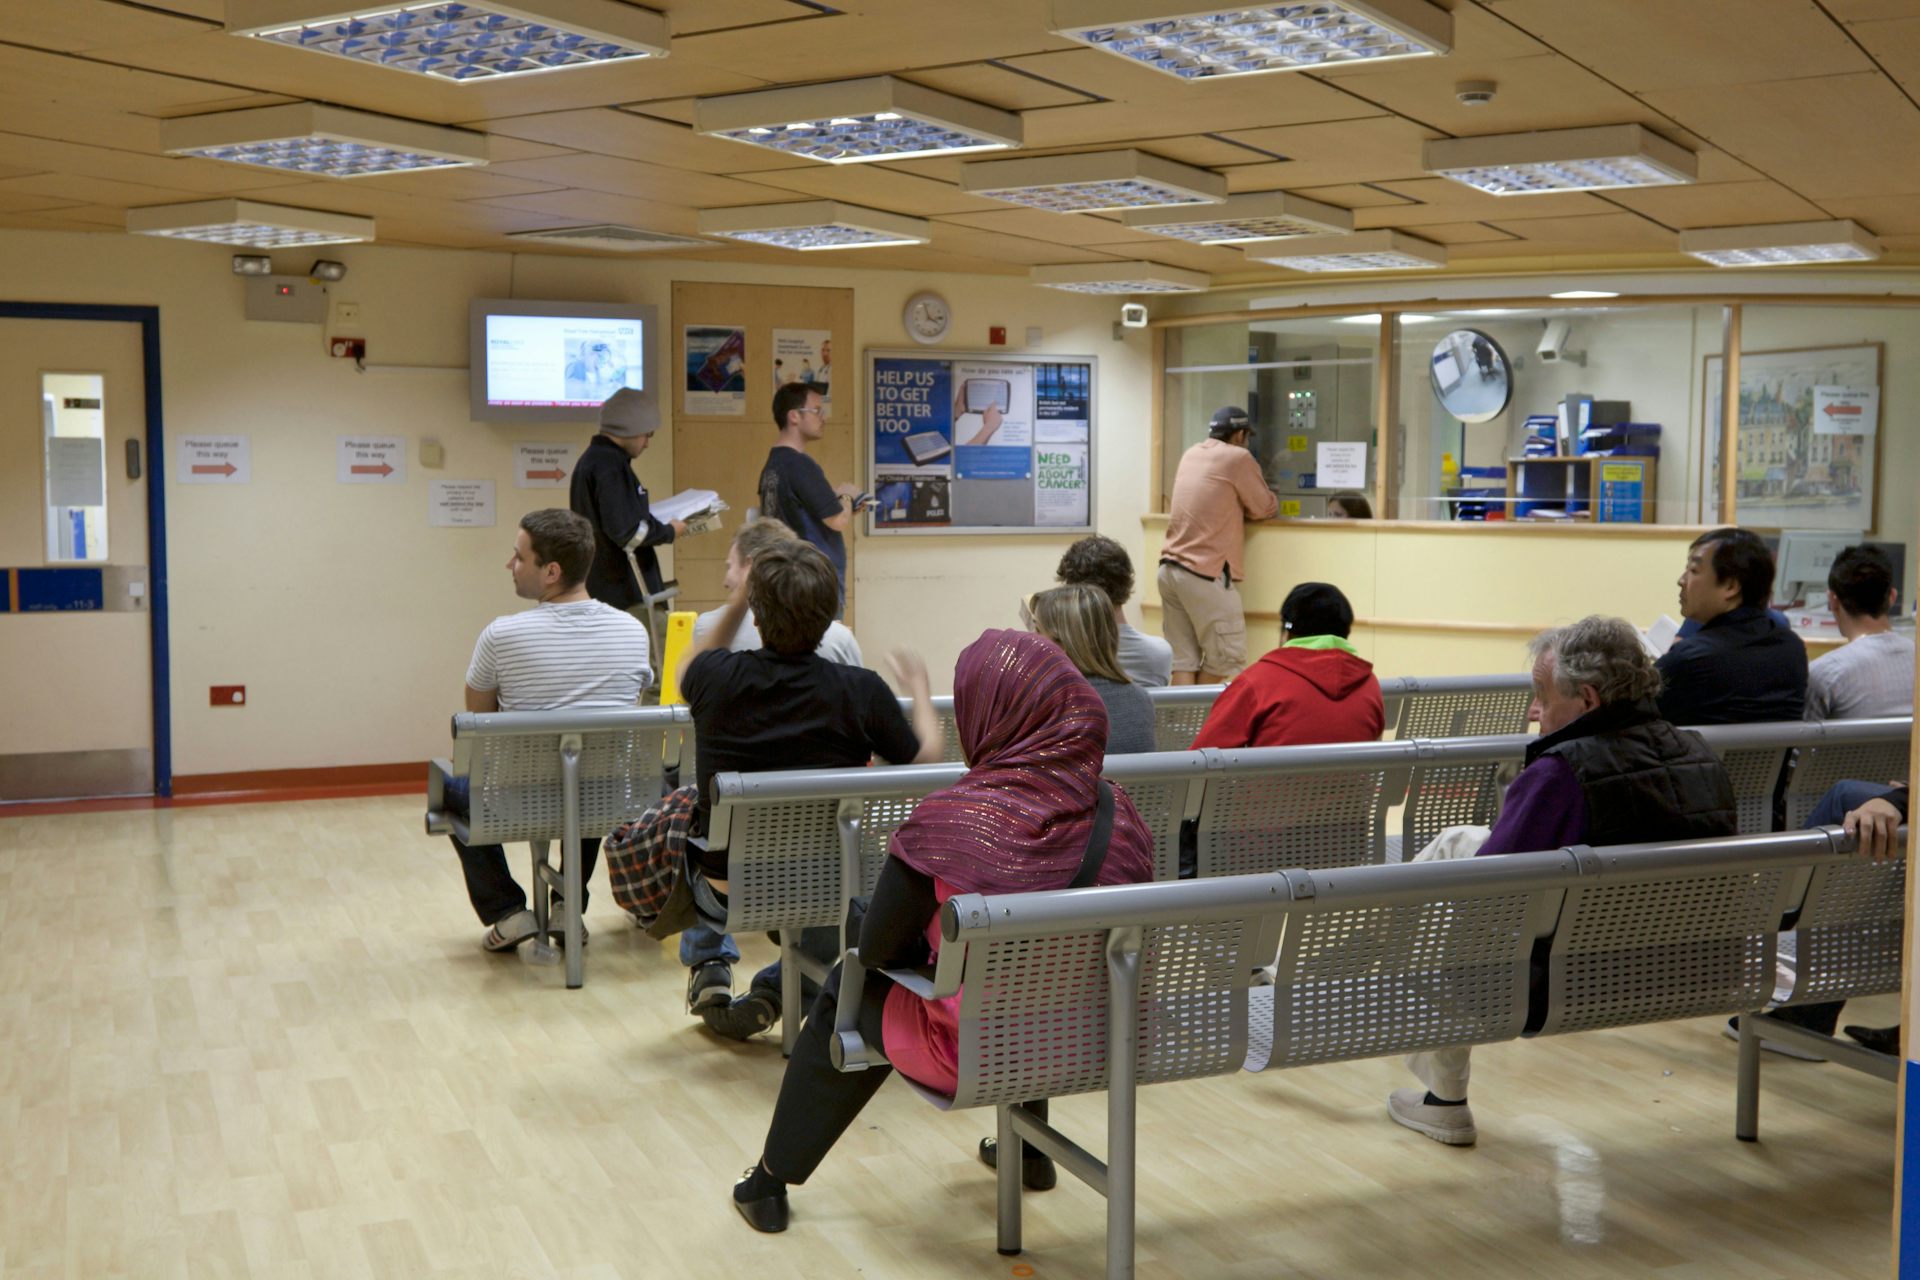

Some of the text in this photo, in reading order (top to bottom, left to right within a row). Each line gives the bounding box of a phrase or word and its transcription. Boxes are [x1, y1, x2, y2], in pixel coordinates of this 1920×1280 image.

[876, 370, 935, 386] HELP US
[877, 386, 930, 402] TO GET
[877, 403, 932, 417] BETTER
[877, 418, 911, 433] TOO
[184, 440, 239, 449] Please queue
[521, 447, 568, 456] Please queue
[1037, 451, 1071, 465] NEED
[530, 456, 559, 465] this way
[1038, 468, 1074, 480] ABOUT
[1038, 479, 1087, 489] CANCER?
